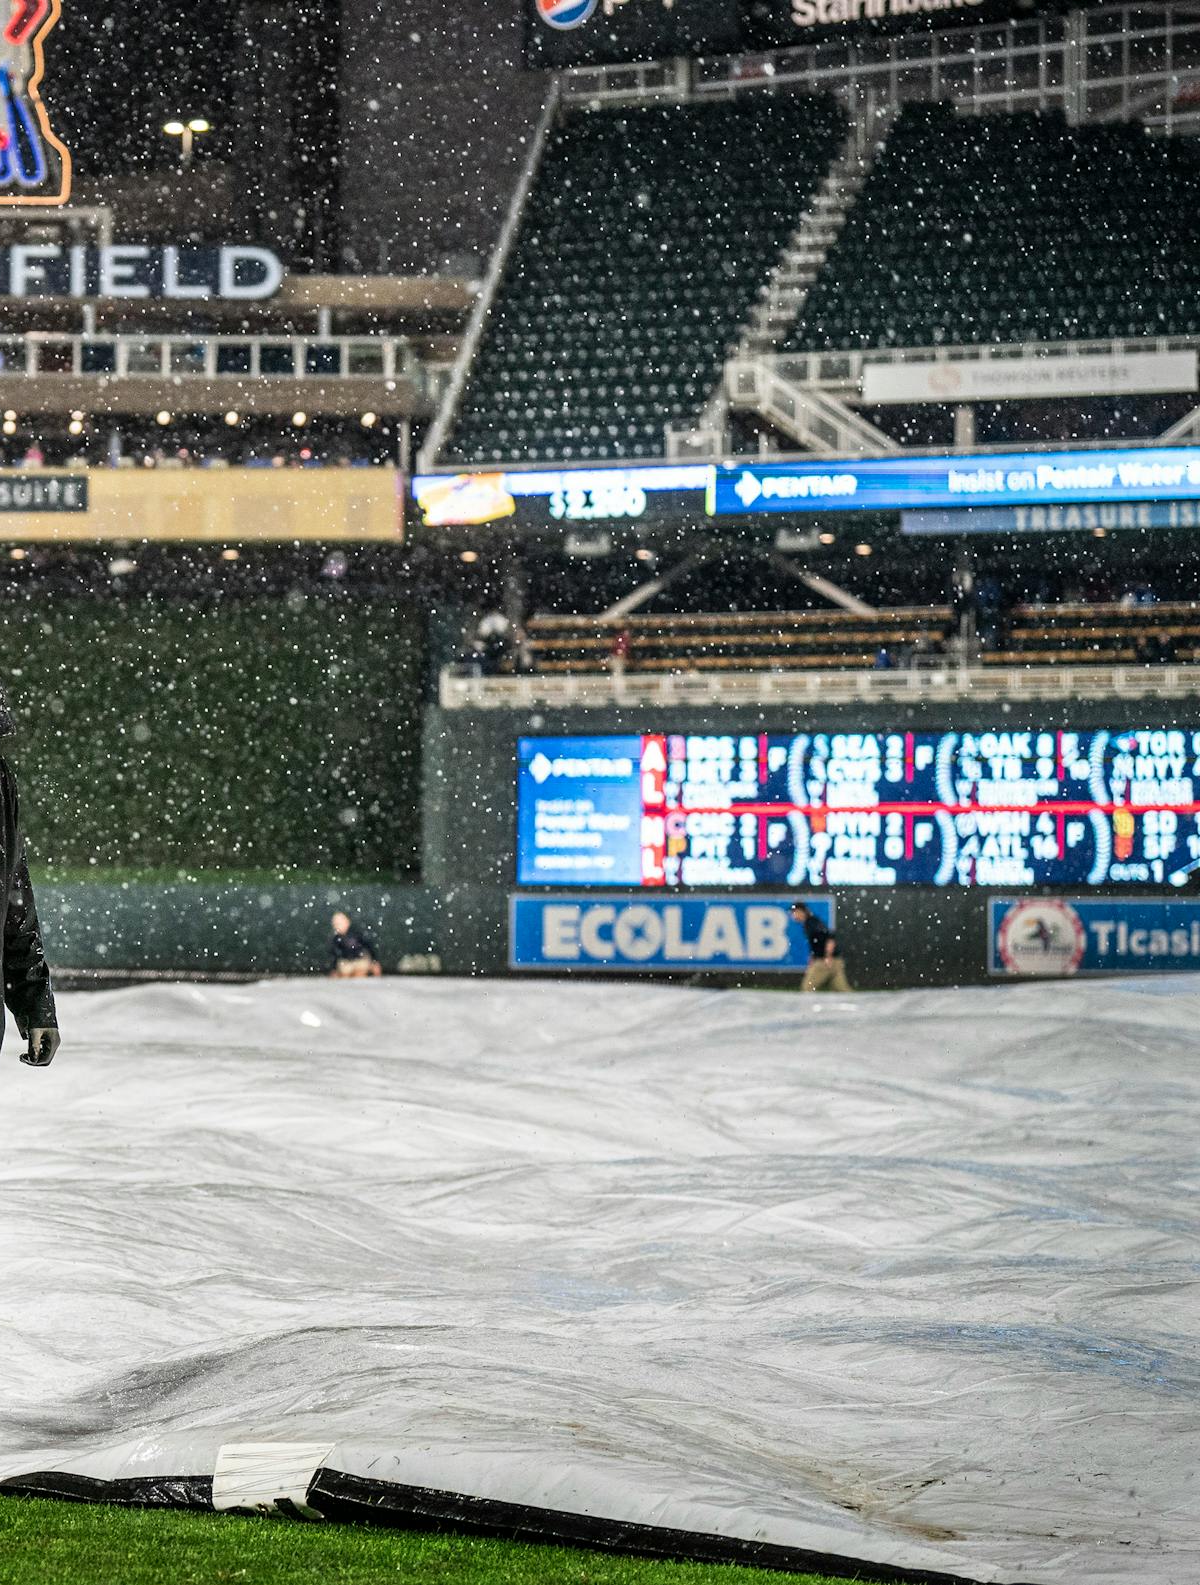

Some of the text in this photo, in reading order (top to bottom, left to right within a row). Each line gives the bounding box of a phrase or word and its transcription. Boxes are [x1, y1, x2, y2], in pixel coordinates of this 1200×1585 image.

[10, 245, 284, 299] FIELD
[1008, 470, 1035, 491] on
[1014, 503, 1150, 532] TREASURE
[980, 732, 1032, 757] OAK
[1135, 731, 1186, 757] TOR
[914, 745, 933, 771] F
[1135, 755, 1186, 779] NYY
[982, 834, 1029, 859] ATL
[1067, 822, 1085, 847] F
[1152, 859, 1164, 883] 1
[543, 904, 789, 961] ECOLAB
